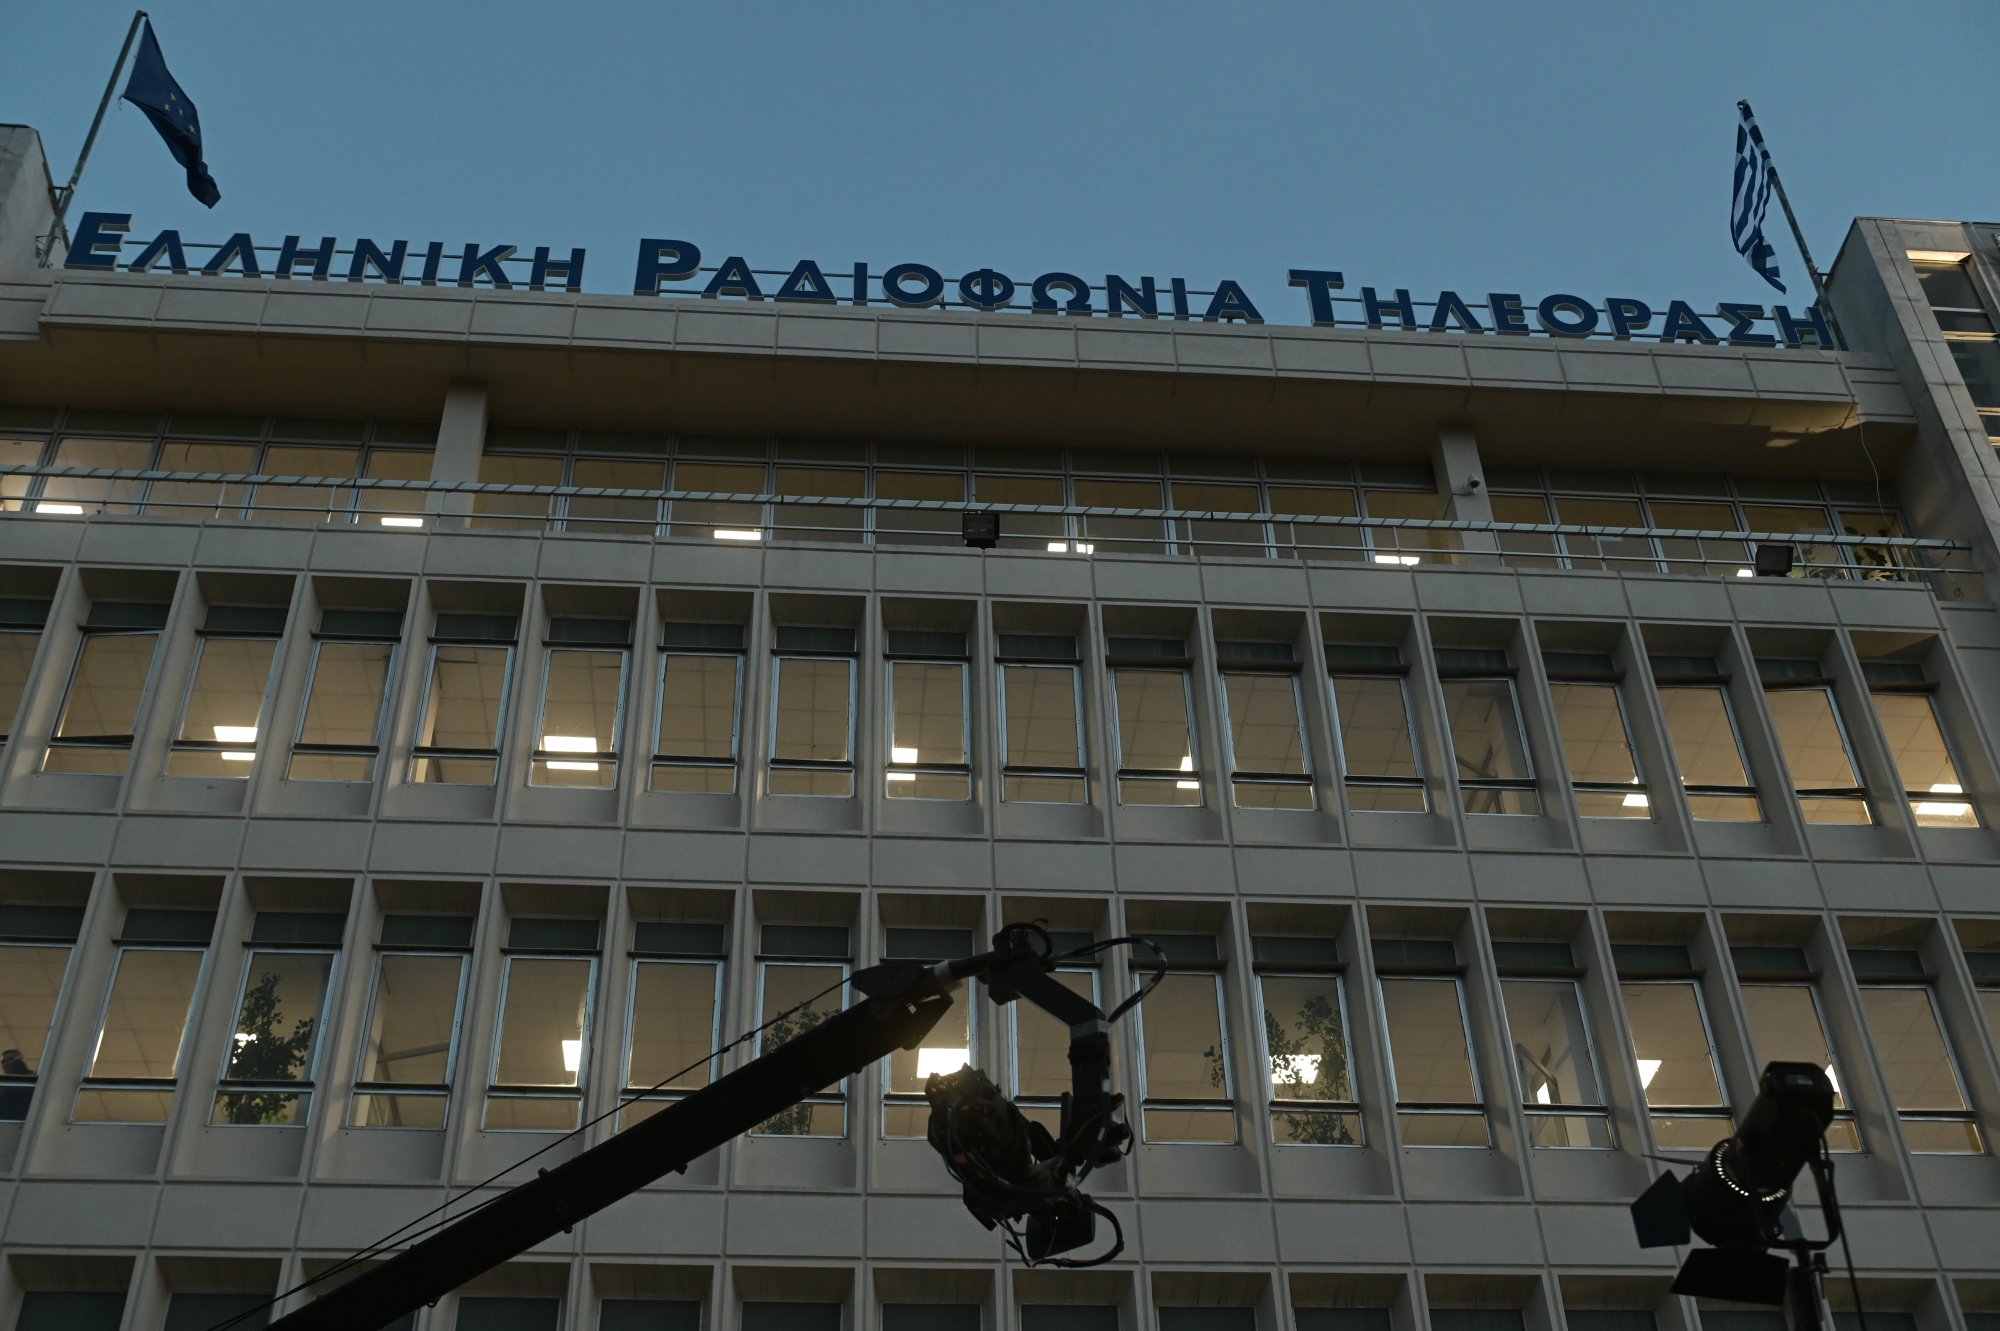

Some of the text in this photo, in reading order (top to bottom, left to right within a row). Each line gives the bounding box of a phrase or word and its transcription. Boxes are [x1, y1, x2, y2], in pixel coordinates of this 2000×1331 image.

[64, 212, 1835, 350] ΕΛΛΗΝΙΚΗ ΡΑΔΙΟΦΩΝΙΑ ΤΗΛΕΟΡΑΣΗ
